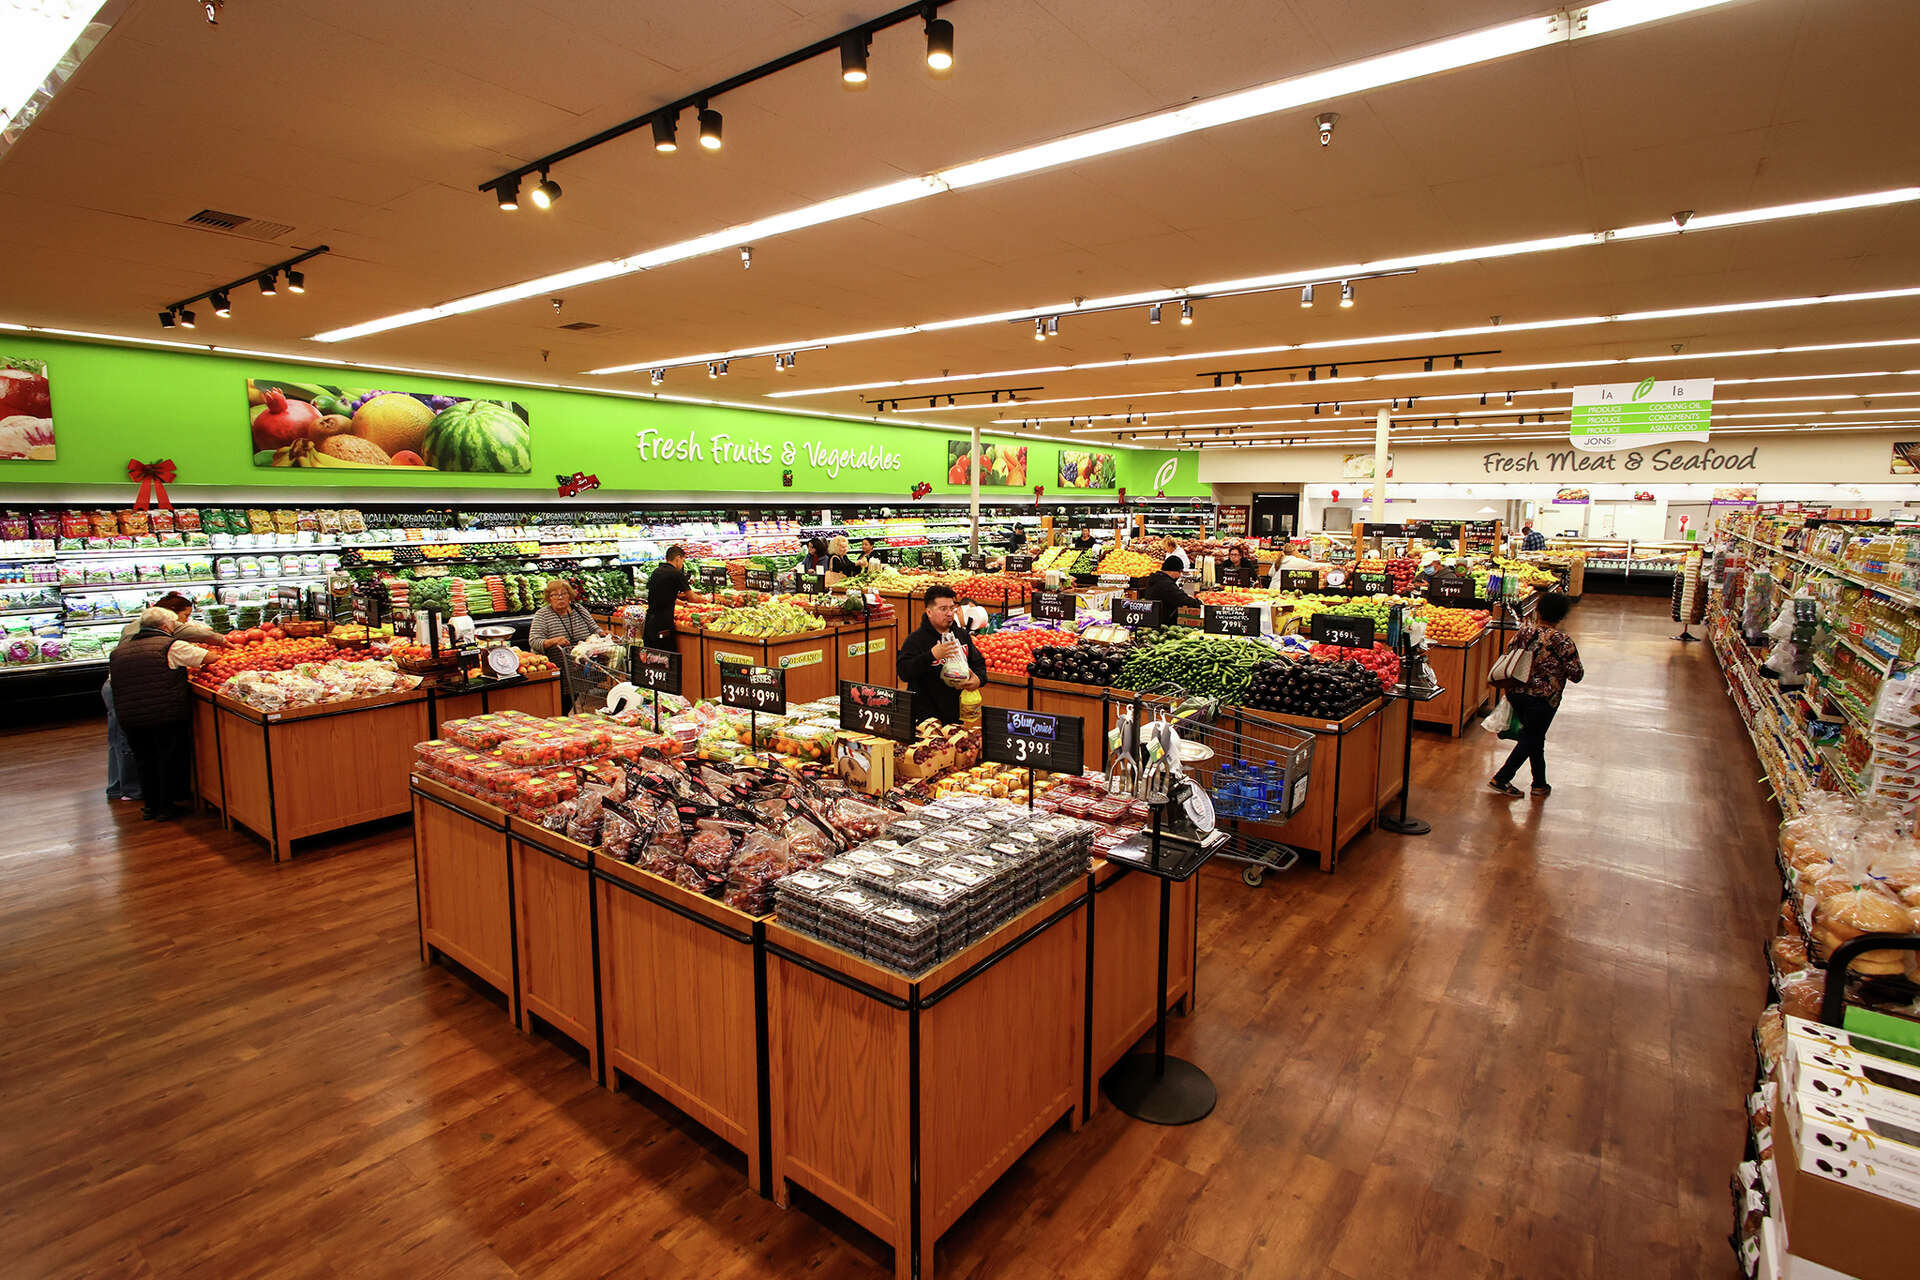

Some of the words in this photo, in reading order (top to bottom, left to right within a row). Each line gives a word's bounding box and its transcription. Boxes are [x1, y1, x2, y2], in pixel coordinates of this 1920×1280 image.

[1649, 402, 1687, 411] COOKING
[1587, 416, 1621, 424] PRODUCE
[1648, 413, 1700, 421] CONDIMENTS
[1586, 426, 1620, 434] PRODUCE
[1583, 437, 1612, 446] JONS
[636, 428, 703, 462] Fresh
[710, 433, 773, 465] Fruits
[780, 440, 797, 466] &
[802, 440, 902, 479] Vegetables
[1483, 452, 1540, 474] Fresh
[1546, 450, 1617, 472] Meat
[1624, 452, 1644, 471] &
[1652, 447, 1759, 472] Seafood
